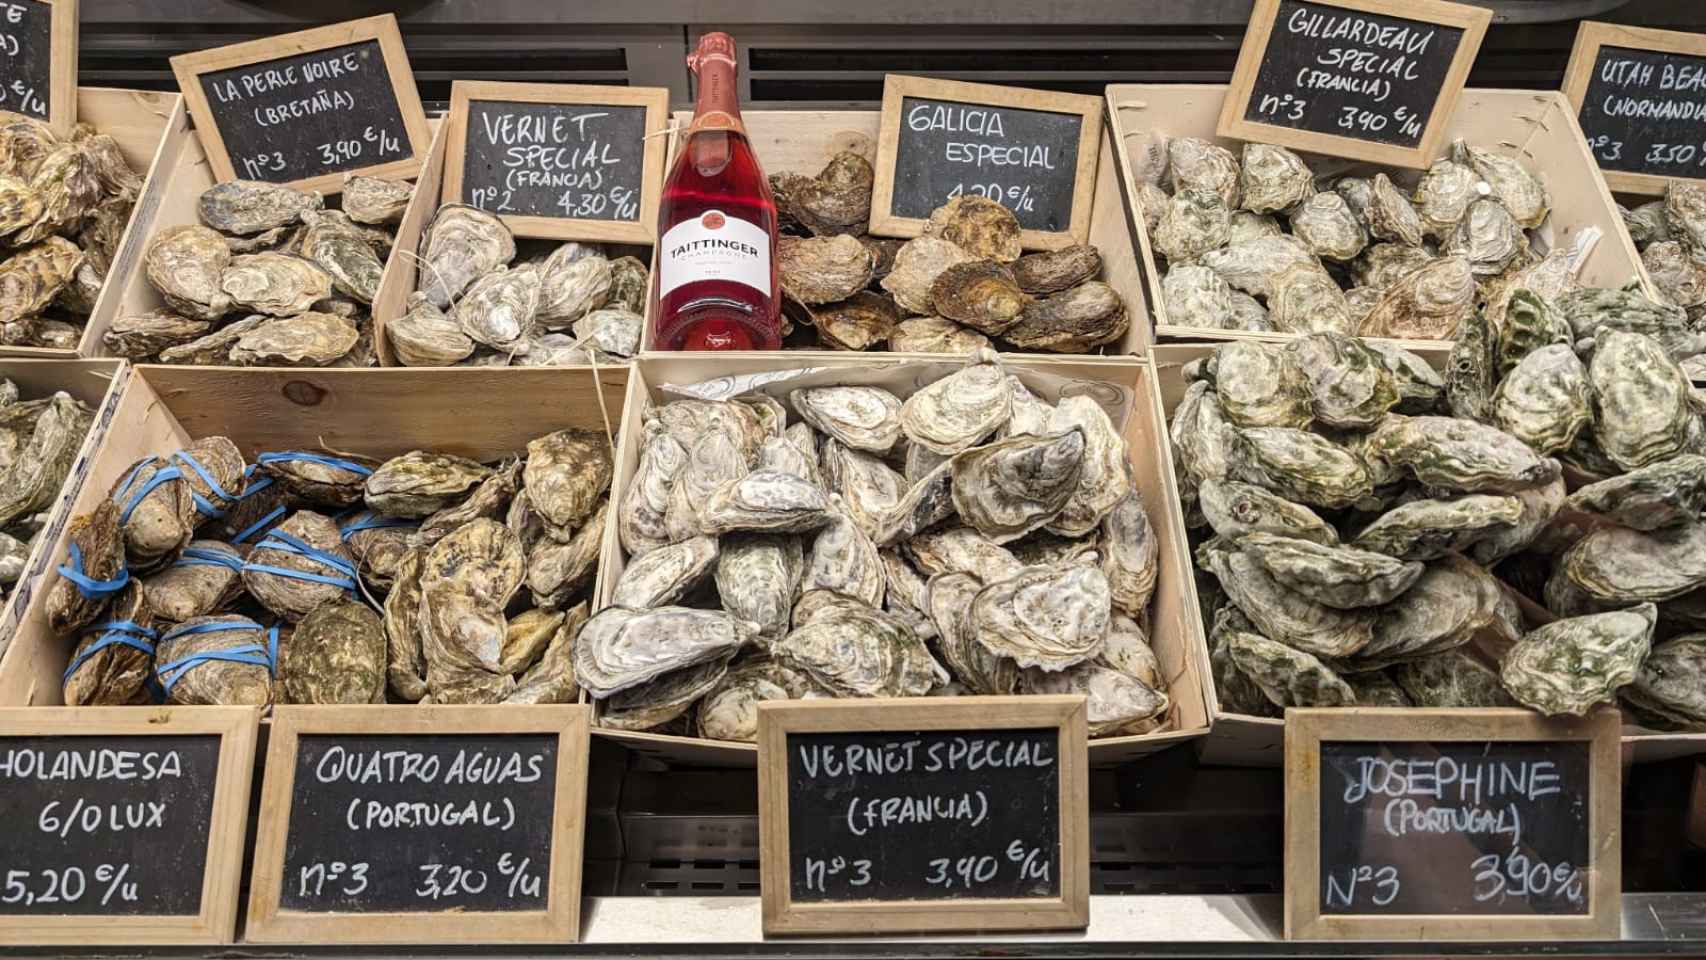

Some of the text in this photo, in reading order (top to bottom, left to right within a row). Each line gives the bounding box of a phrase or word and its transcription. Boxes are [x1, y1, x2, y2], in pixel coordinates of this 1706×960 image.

[1288, 8, 1434, 55] GILLARDEAU
[213, 52, 359, 103] LA PERLE NOIRE
[1317, 48, 1419, 81] SPECIAL
[1602, 59, 1654, 88] UTAH
[1296, 68, 1390, 101] (FRANCIA)
[254, 89, 354, 126] (BRETAÑA)
[908, 104, 1005, 138] GALICIA
[482, 111, 609, 145] VERNET
[503, 139, 621, 170] SPECIAL
[945, 142, 1055, 169] ESPECIAL
[506, 168, 603, 191] (FRANCIA)
[670, 238, 759, 260] TAITTINGER
[0, 749, 181, 780] HOLANDESA
[316, 746, 543, 785] QUATRO AGUAS
[800, 737, 1053, 778] VERNET SPECIAL
[1344, 756, 1561, 804] JOSEPHINE
[110, 802, 166, 831] LUX
[347, 798, 515, 830] (PORTUGAL)
[1, 867, 86, 905] 5,20
[925, 855, 998, 889] 3,90
